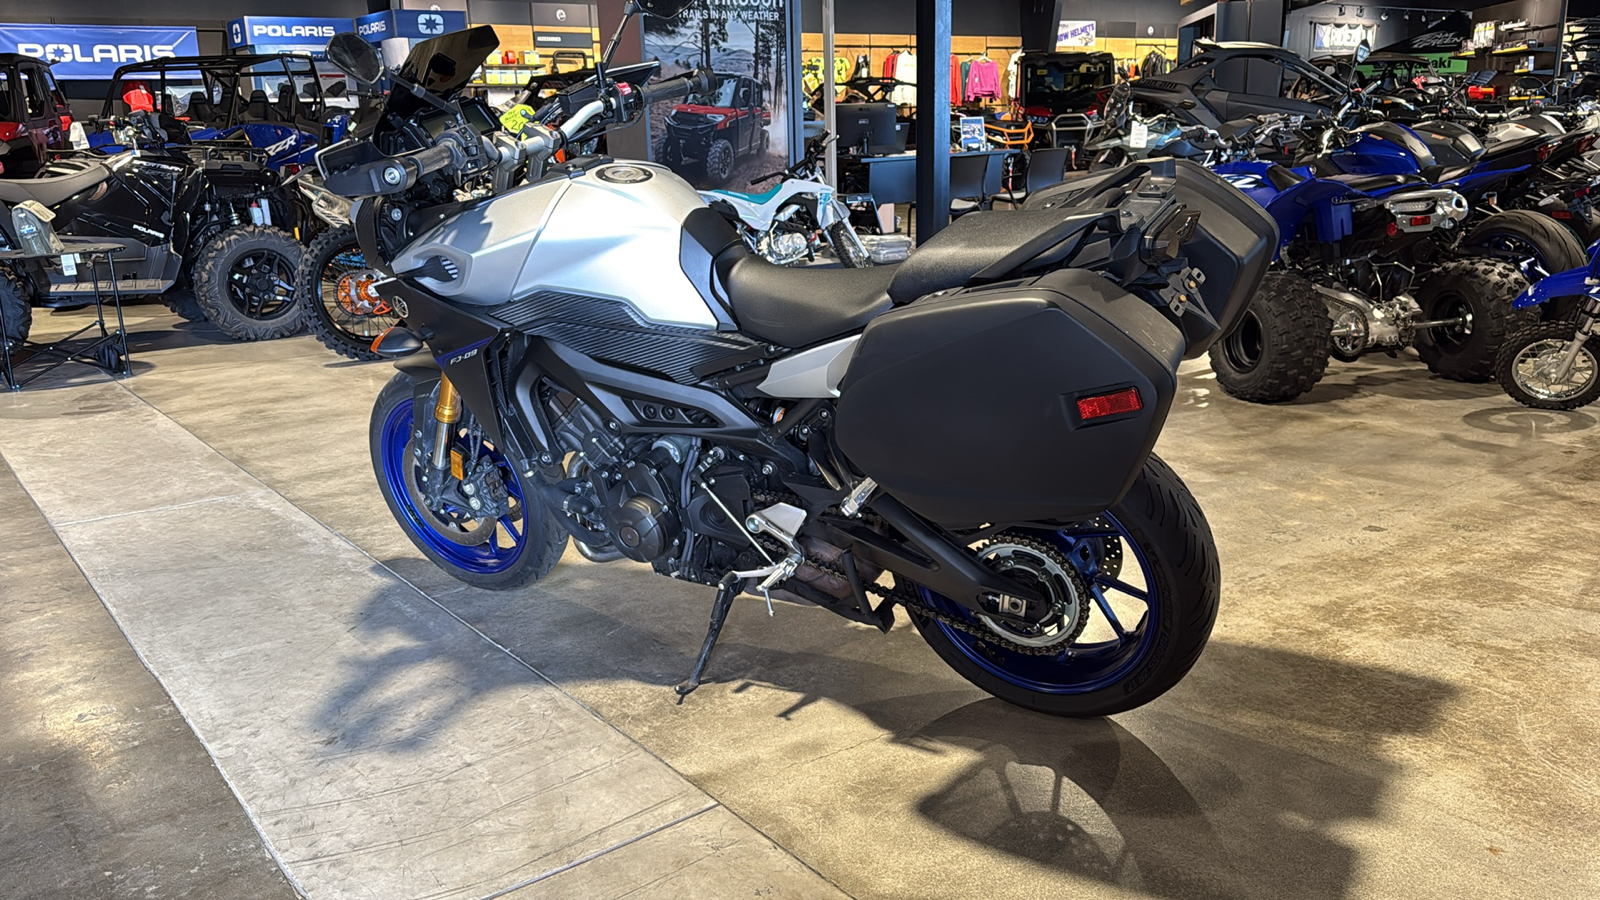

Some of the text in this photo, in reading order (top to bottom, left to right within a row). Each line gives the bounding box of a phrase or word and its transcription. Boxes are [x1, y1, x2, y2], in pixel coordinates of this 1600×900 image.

[711, 10, 720, 19] IN
[721, 10, 738, 19] ANY
[740, 10, 780, 20] WEATHER
[253, 25, 336, 37] POLARIS
[358, 20, 387, 36] POLARIS
[1070, 23, 1095, 38] HELMETS
[17, 43, 176, 63] POLARIS
[132, 223, 165, 238] POLARIS
[450, 348, 478, 365] FJ-09
